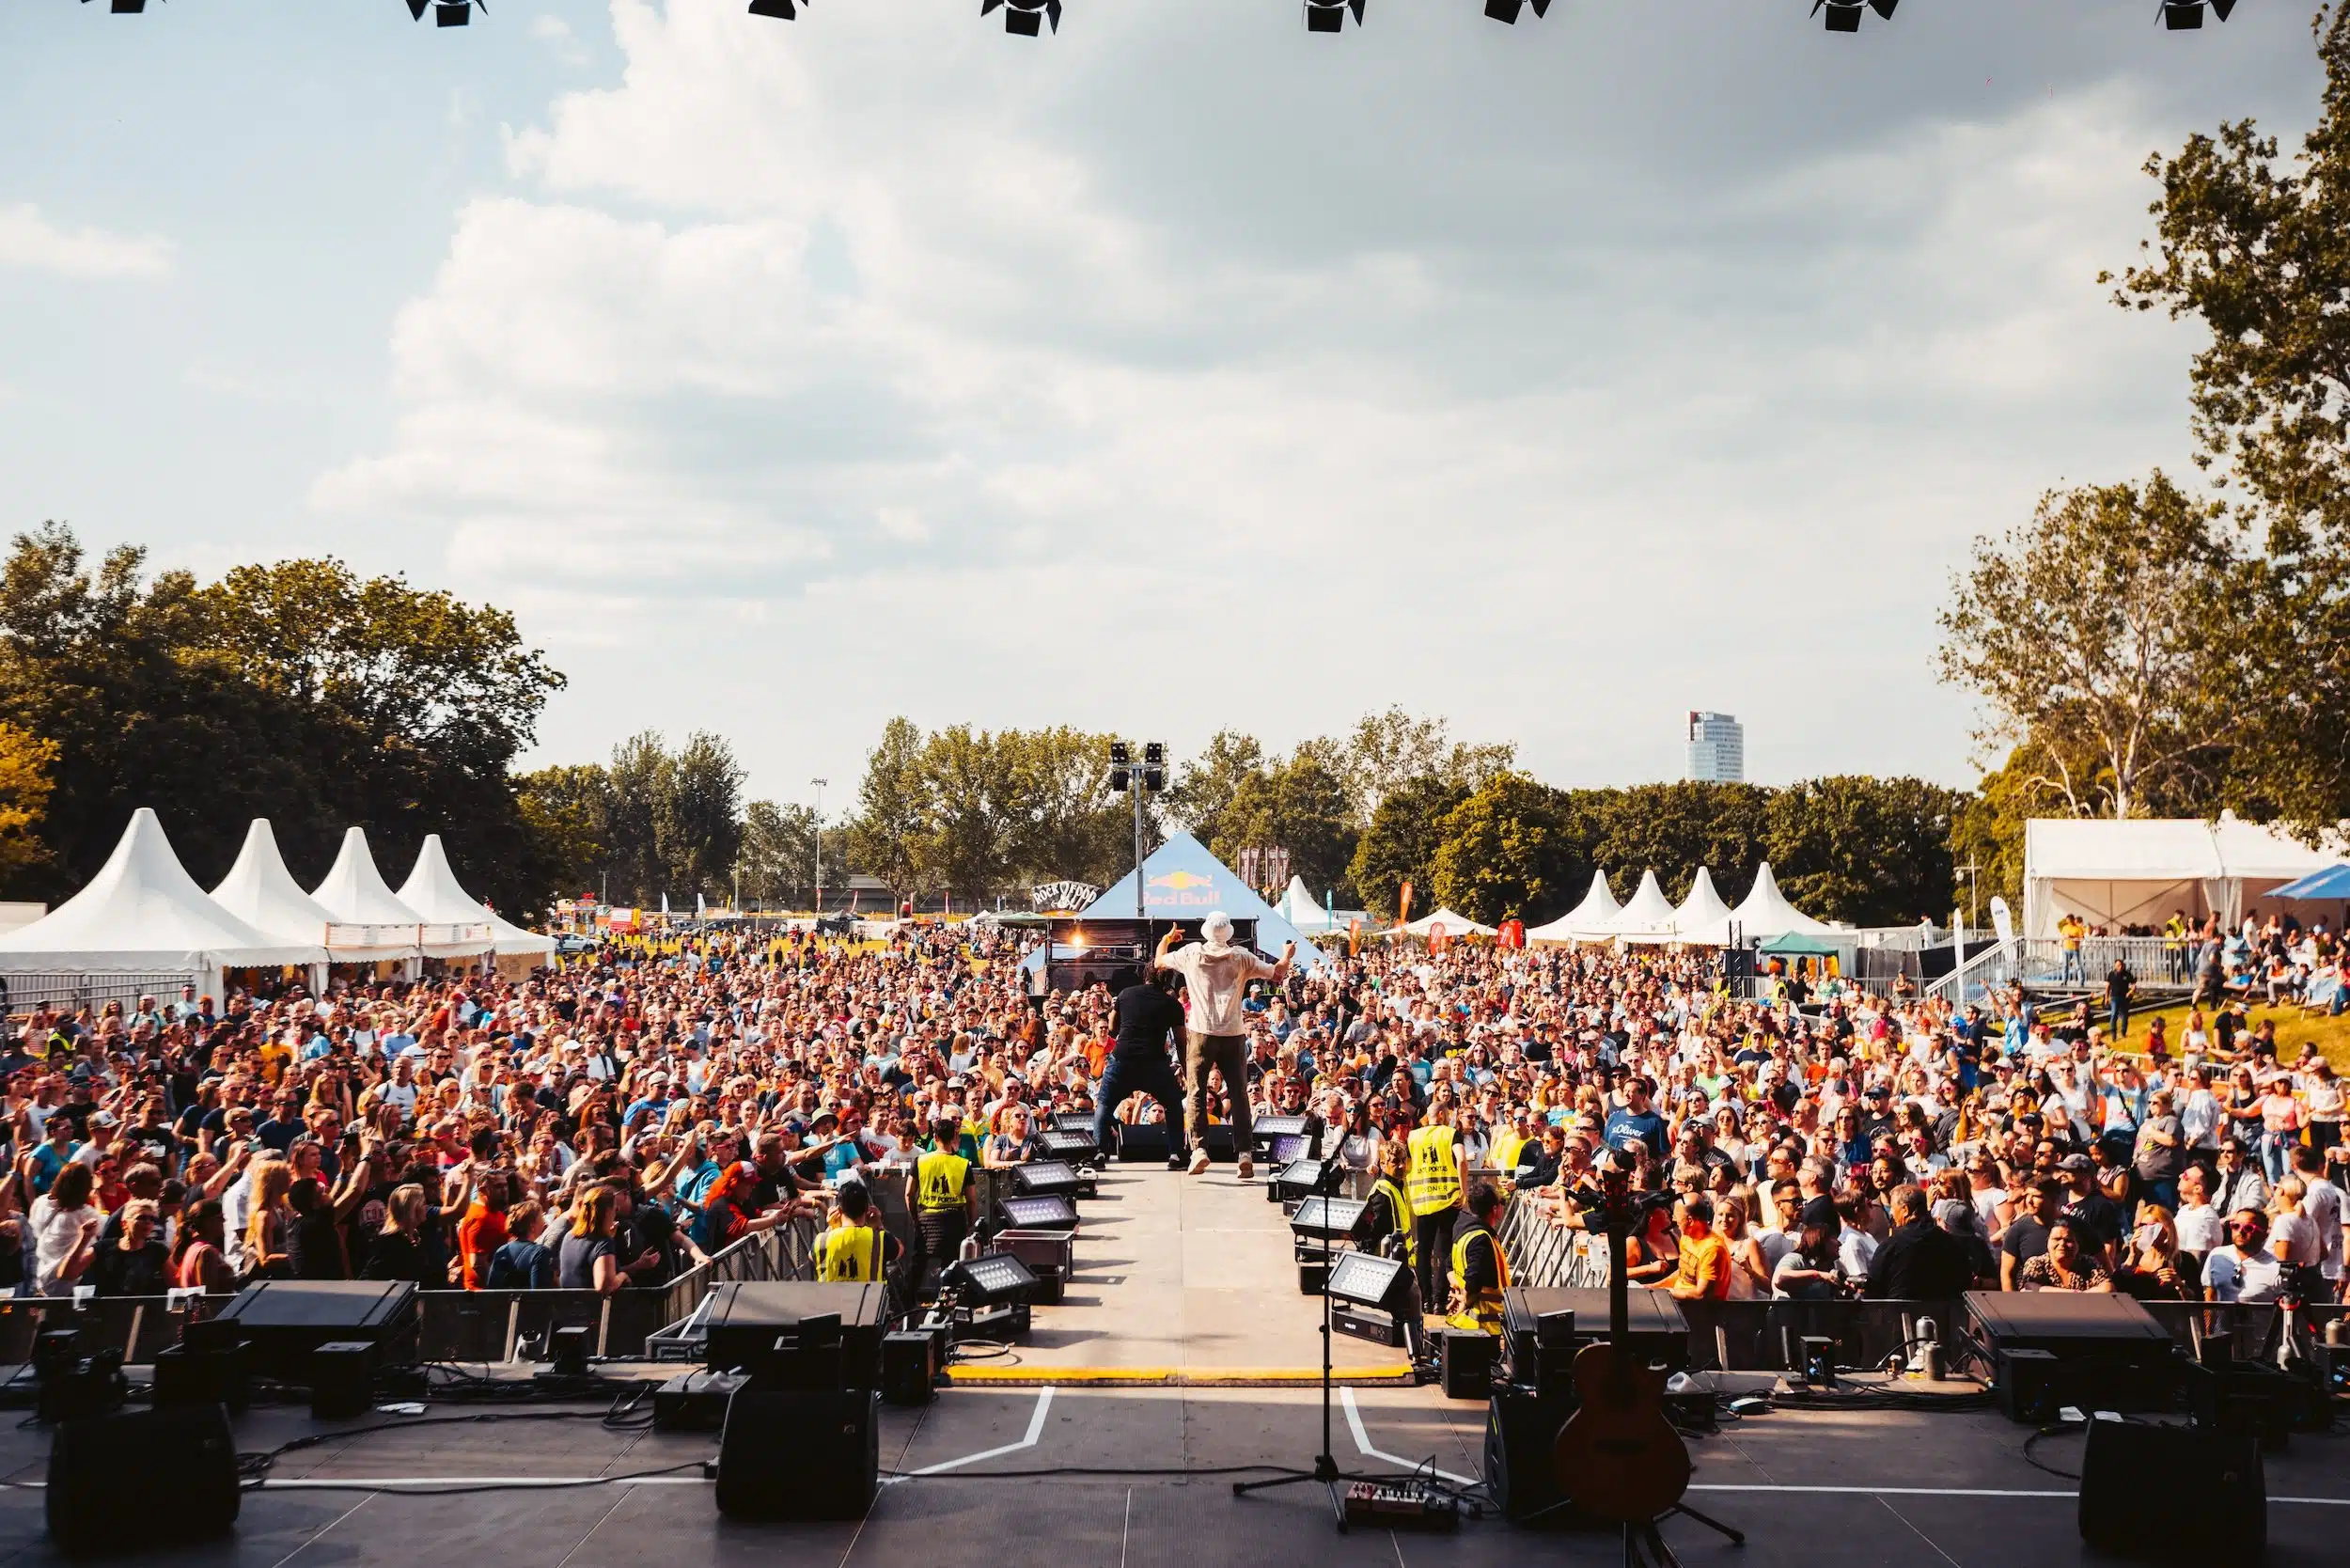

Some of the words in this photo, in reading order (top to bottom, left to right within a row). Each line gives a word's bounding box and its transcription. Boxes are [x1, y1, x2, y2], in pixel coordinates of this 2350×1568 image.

[1033, 885, 1059, 905] ROCK
[1142, 890, 1178, 905] Red
[1180, 890, 1220, 905] Bull
